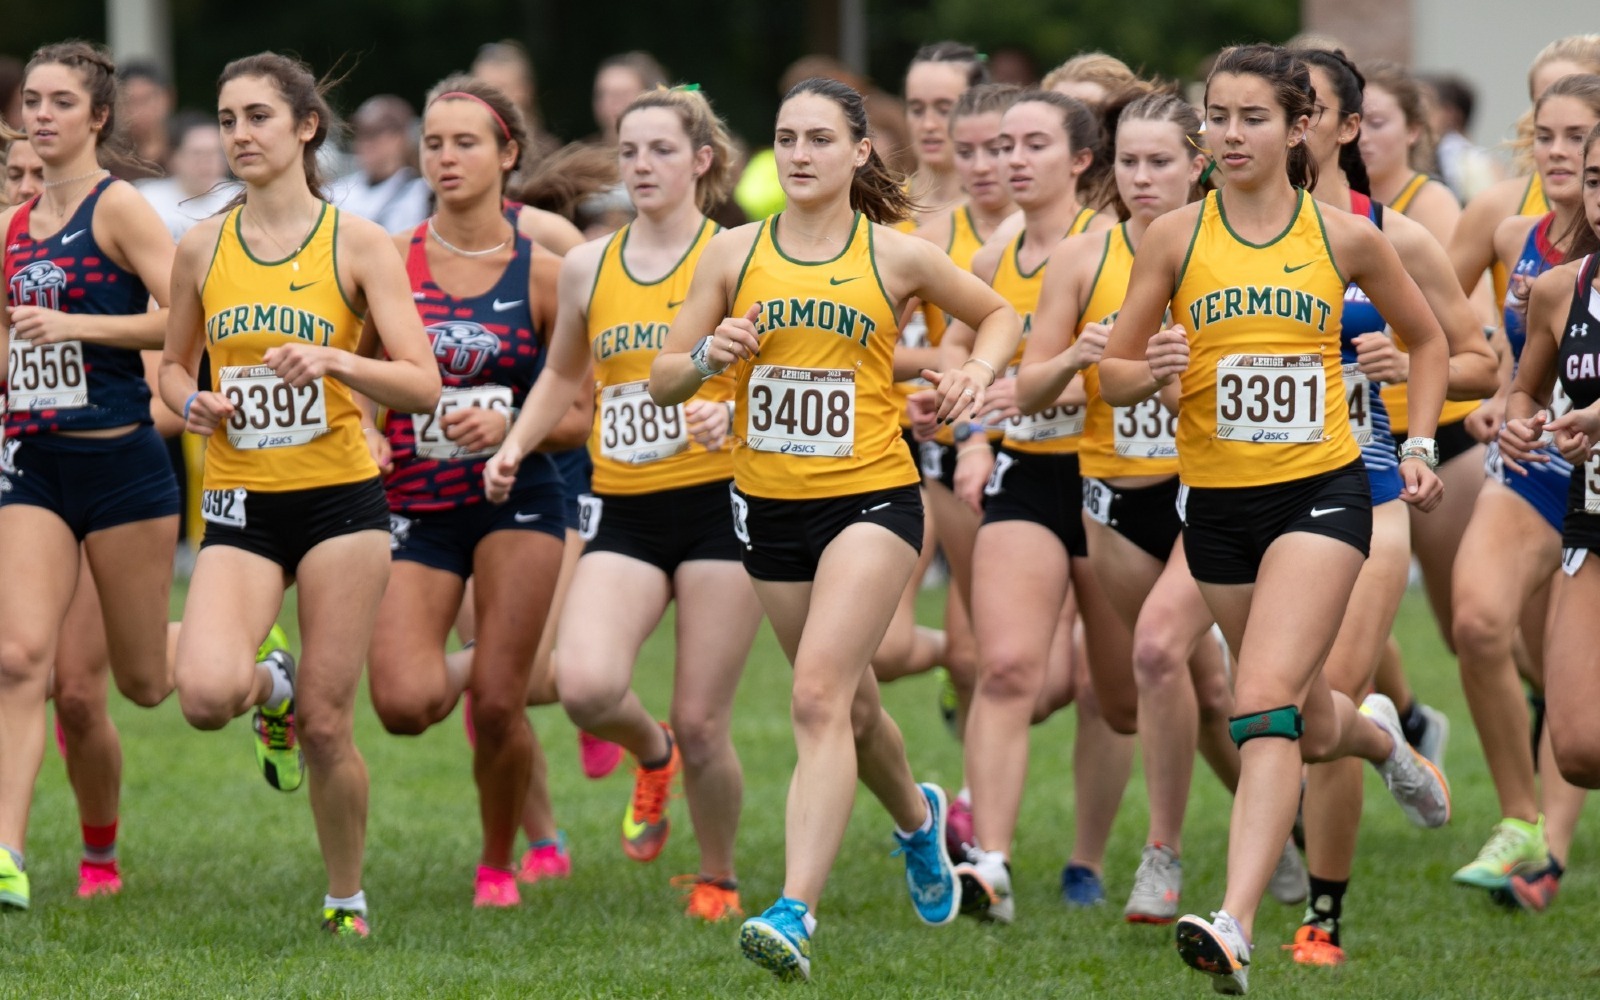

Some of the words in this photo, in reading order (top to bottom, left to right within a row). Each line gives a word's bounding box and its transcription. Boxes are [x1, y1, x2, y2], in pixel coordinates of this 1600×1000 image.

[206, 303, 335, 347] VERMONT
[1189, 286, 1332, 332] VERMONT
[10, 344, 81, 390] 2556
[781, 369, 811, 380] LEHIGH
[1252, 357, 1284, 367] LEHIGH
[1566, 353, 1600, 380] CA
[225, 381, 322, 431] 3392
[752, 384, 851, 438] 3408
[1220, 373, 1318, 423] 3391
[269, 435, 293, 445] asics
[604, 401, 682, 449] 3389
[1264, 431, 1290, 441] asics
[791, 444, 816, 453] asics
